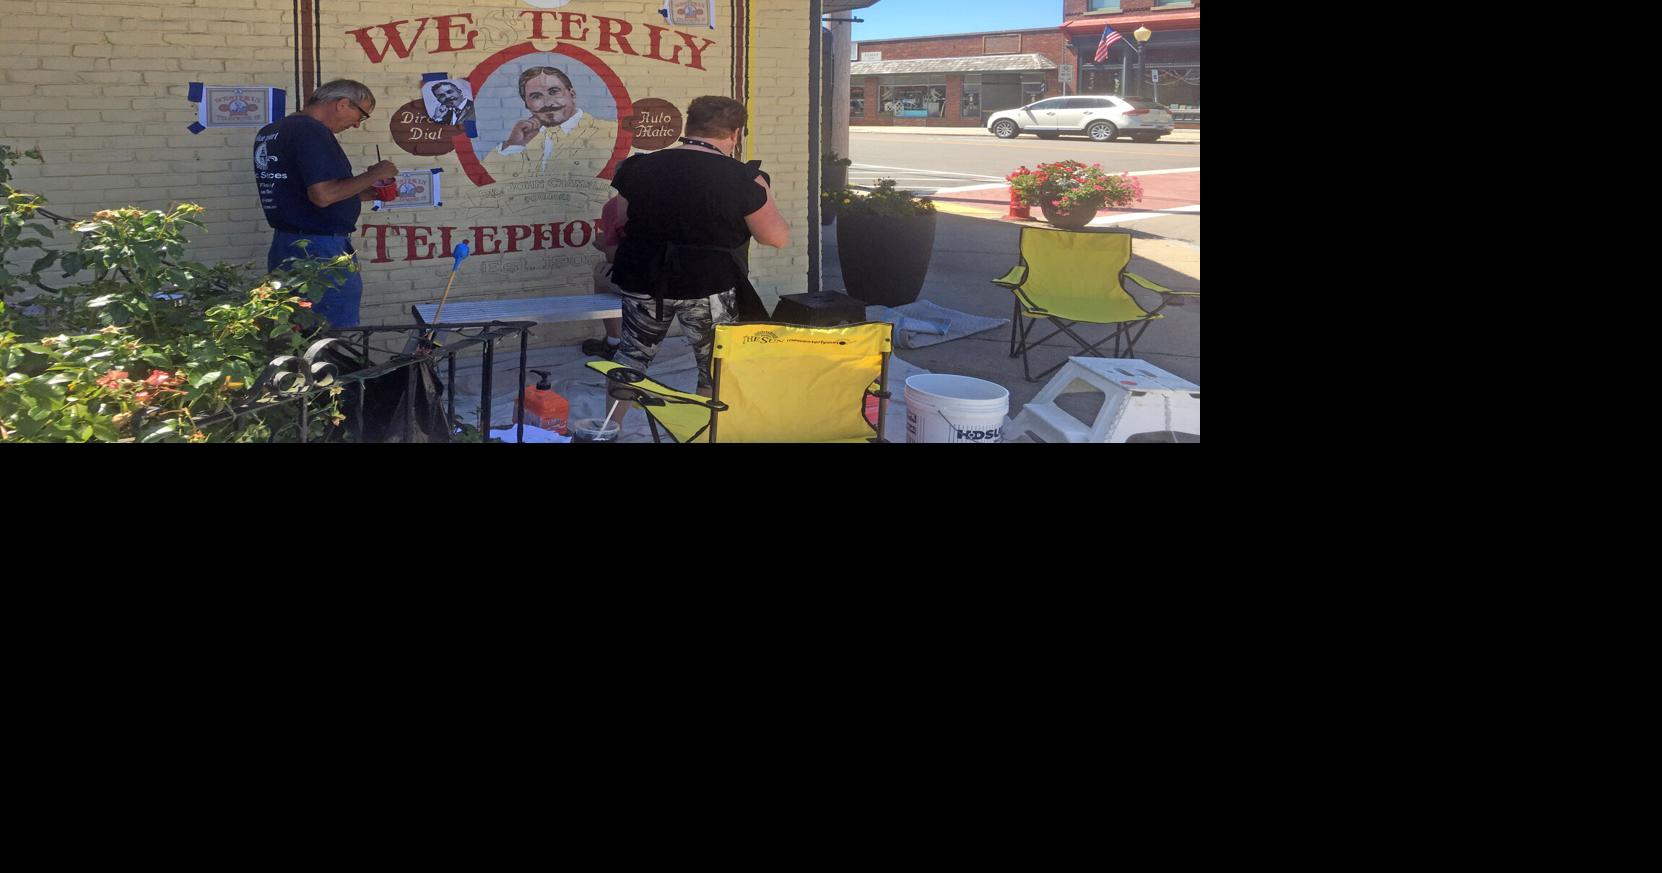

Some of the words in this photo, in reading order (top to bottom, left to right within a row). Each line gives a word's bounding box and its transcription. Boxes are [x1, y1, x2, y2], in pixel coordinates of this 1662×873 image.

[639, 111, 672, 124] Auto
[408, 127, 443, 141] Dial
[635, 124, 675, 138] Matic
[361, 218, 603, 264] TELEPHO
